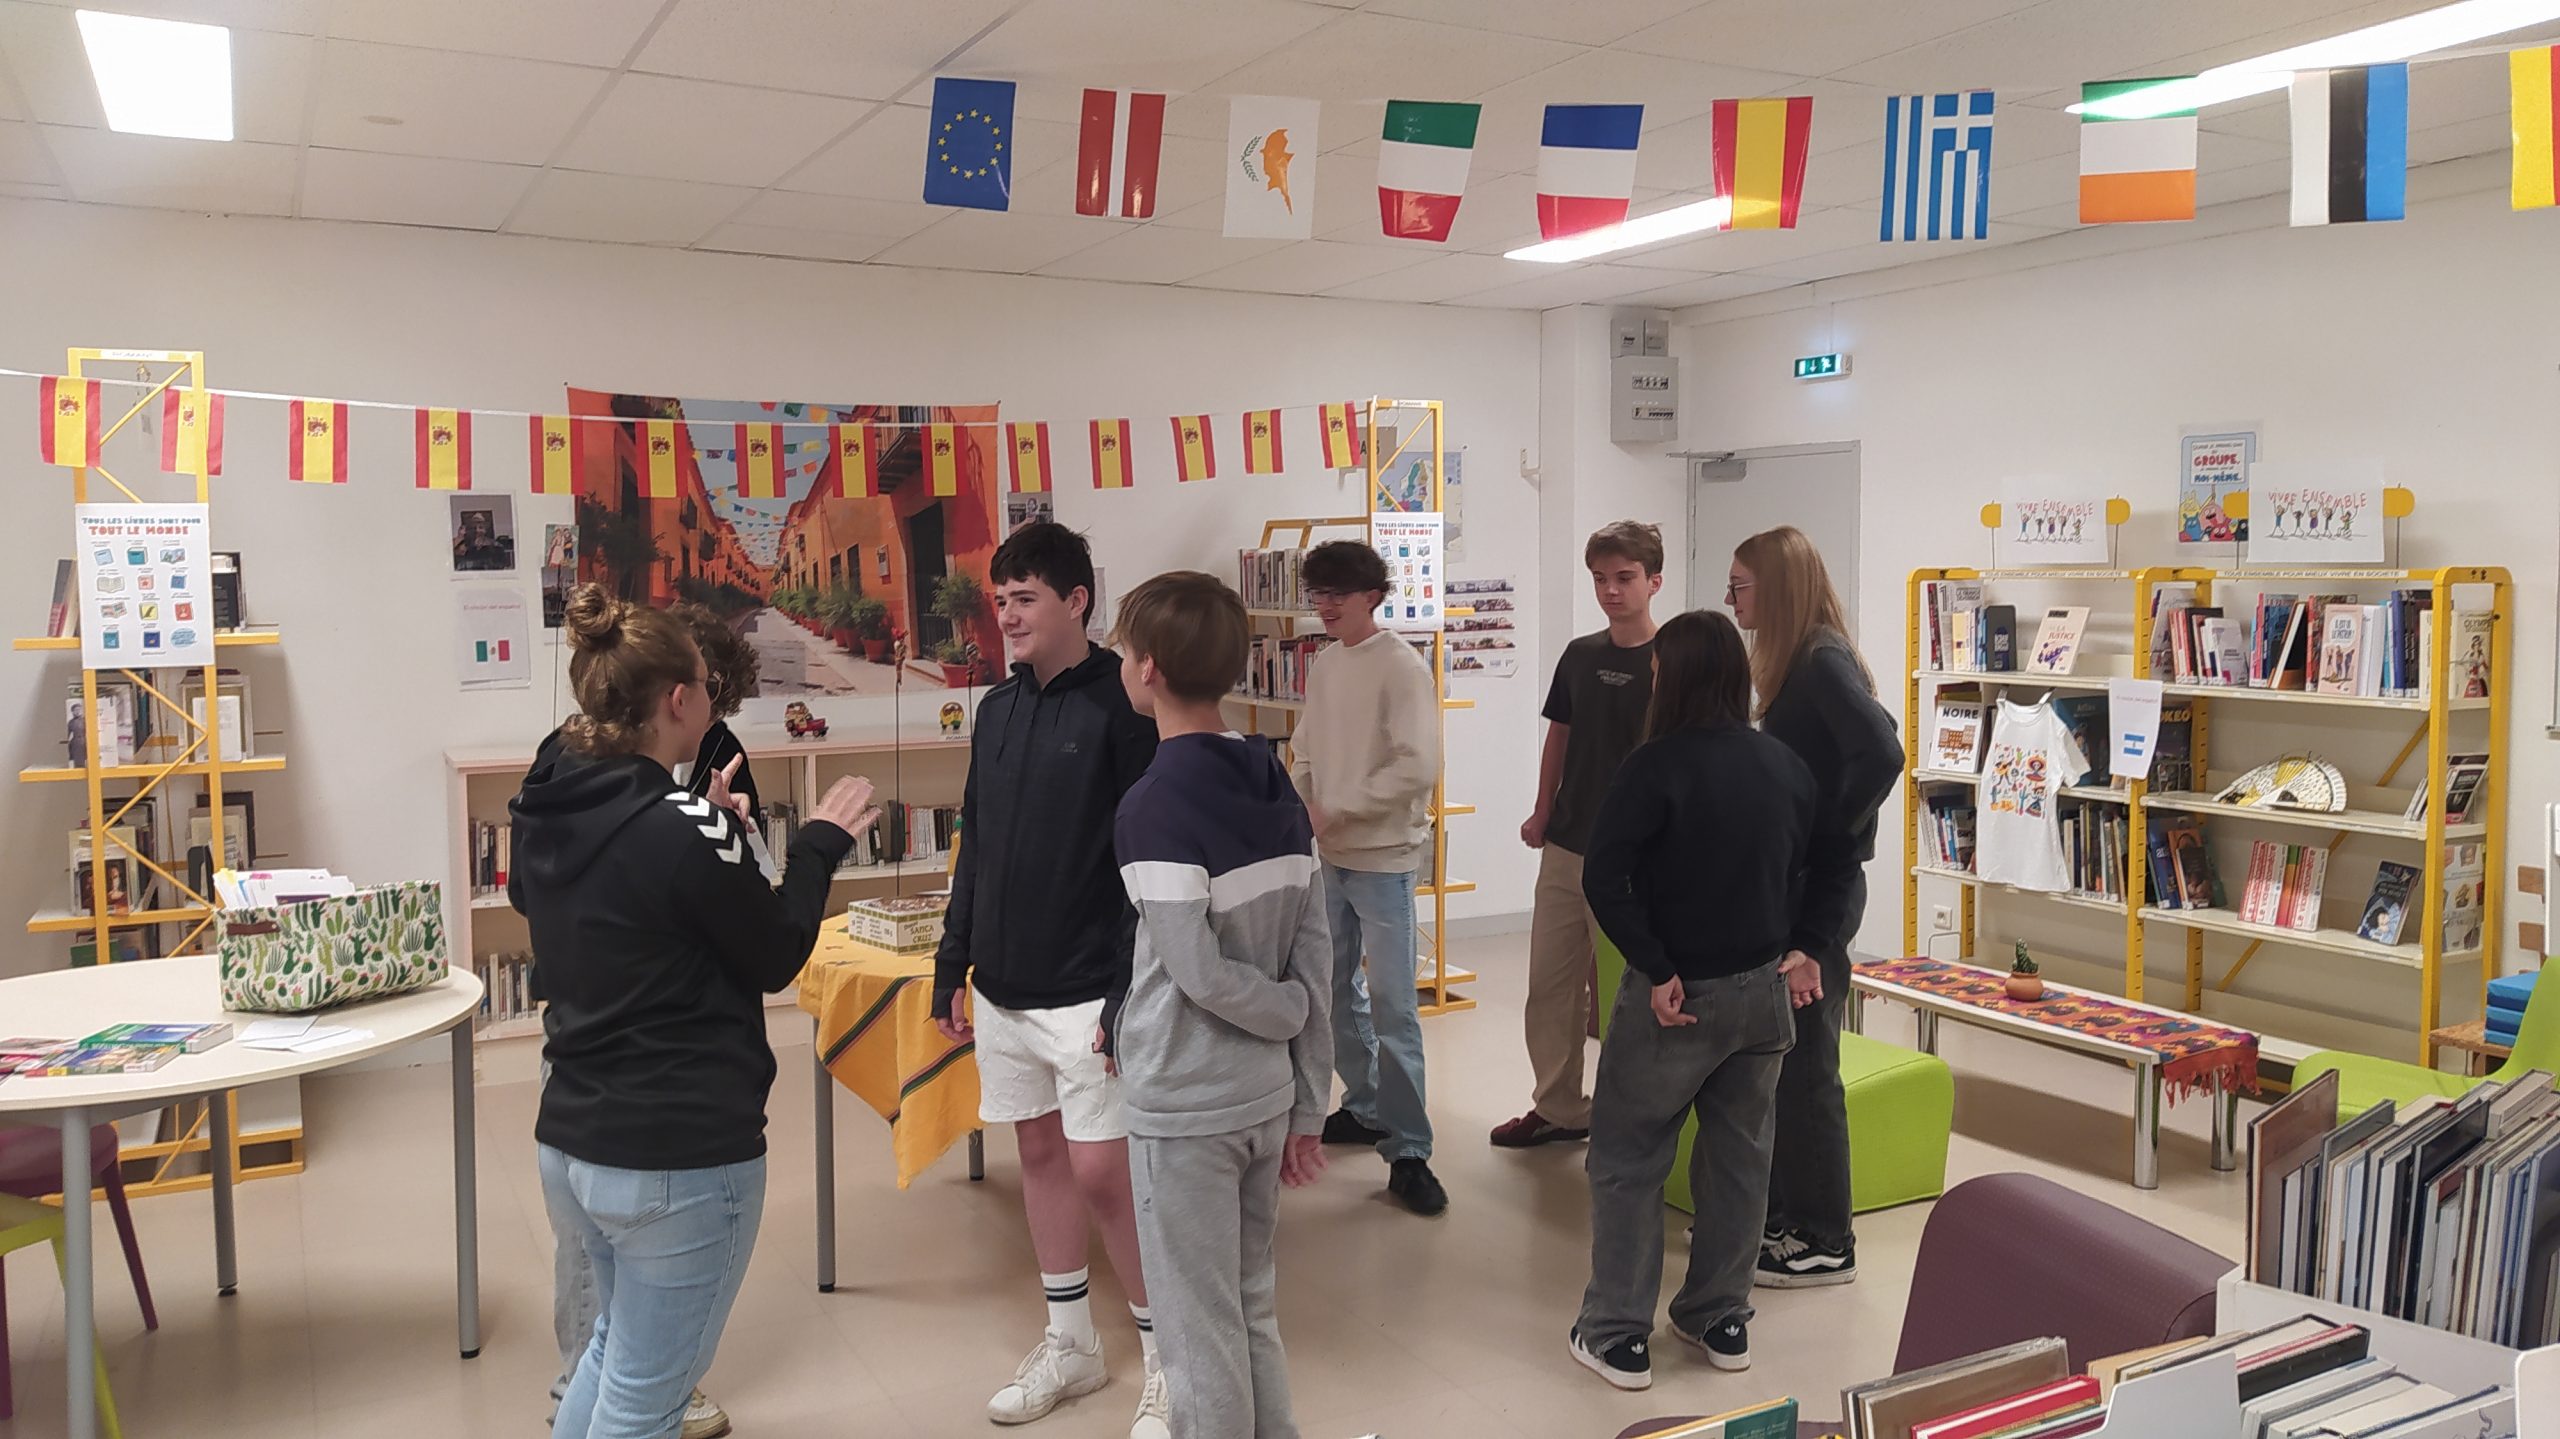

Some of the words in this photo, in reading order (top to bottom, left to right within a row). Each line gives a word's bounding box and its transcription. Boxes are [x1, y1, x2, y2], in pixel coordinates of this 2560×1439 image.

[2301, 488, 2367, 508] ENSEMBLE
[2042, 499, 2094, 516] ENSEMBLE
[88, 526, 123, 535] TOUT
[127, 526, 140, 535] LE
[145, 526, 189, 535] MONDE
[2047, 631, 2076, 640] JUSTICE
[1942, 707, 1979, 720] NOIRE
